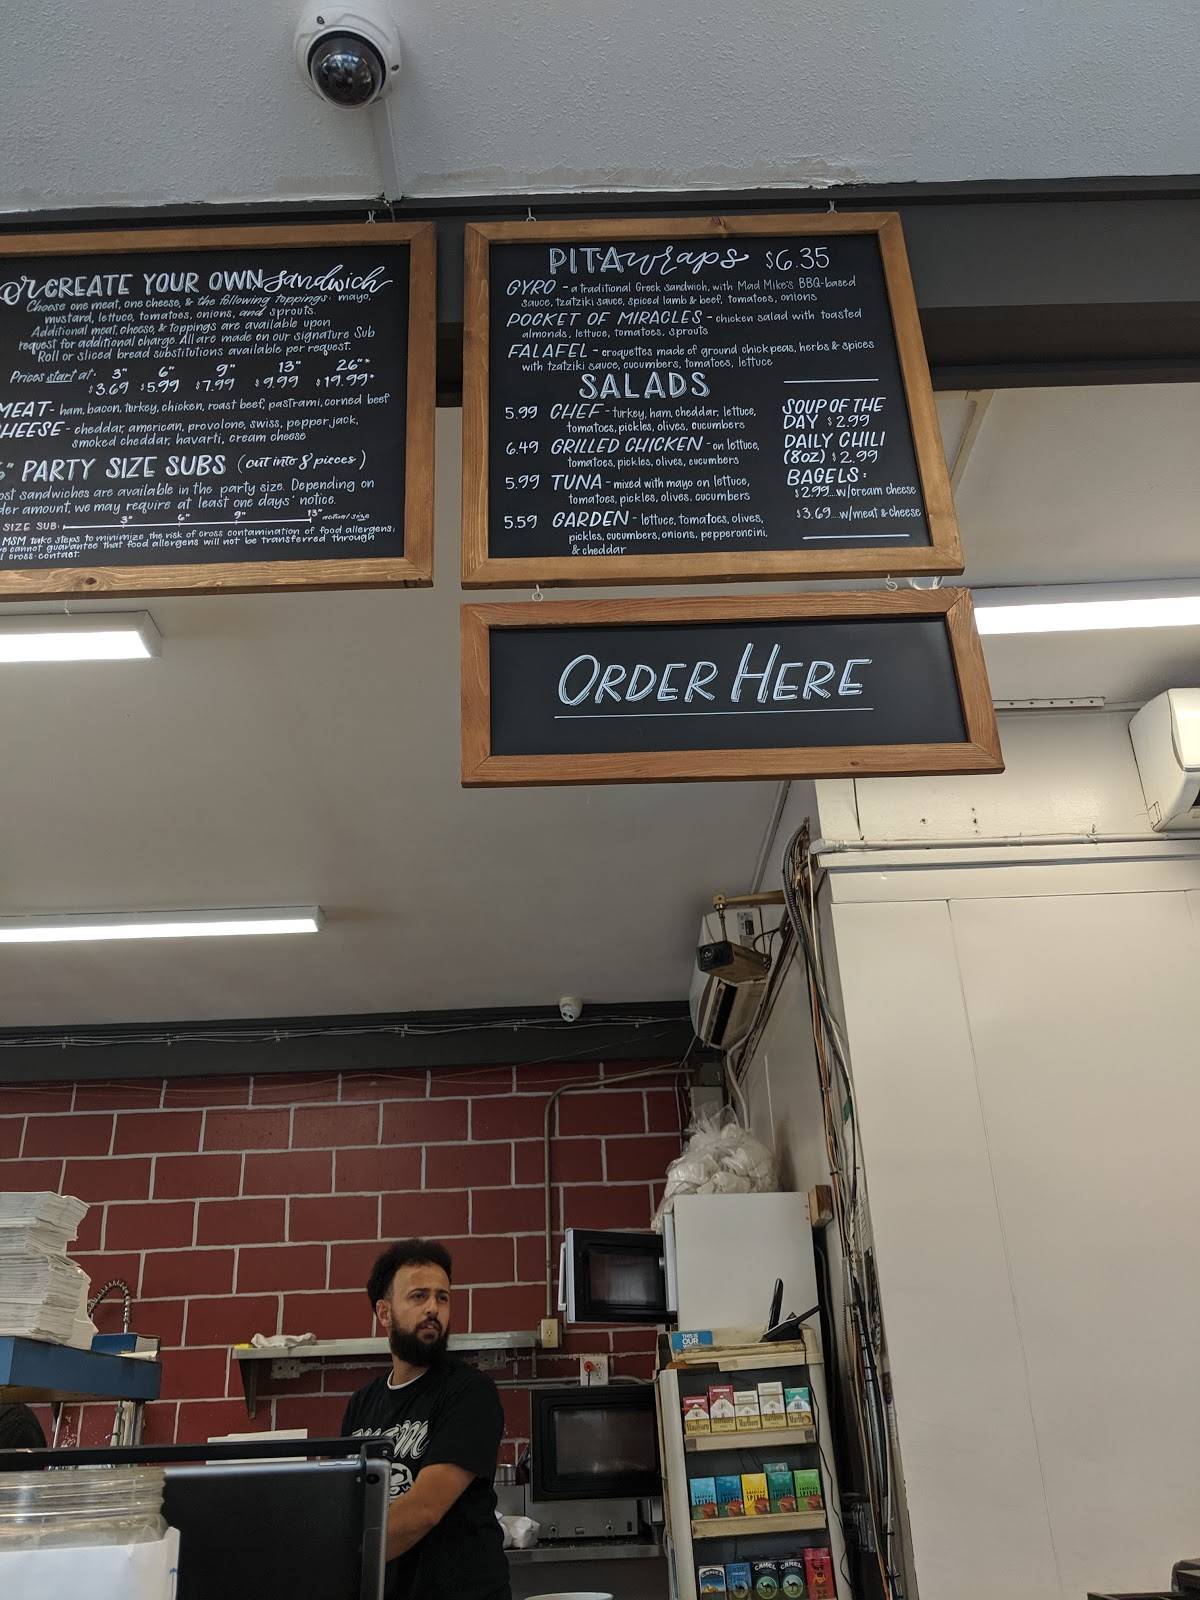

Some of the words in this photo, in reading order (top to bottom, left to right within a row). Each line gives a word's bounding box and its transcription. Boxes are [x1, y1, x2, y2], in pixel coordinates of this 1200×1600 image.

[550, 246, 624, 275] PITA
[766, 247, 829, 270] $6.35
[45, 274, 133, 298] CREATE
[144, 272, 199, 295] YOUR
[209, 269, 263, 291] OWN
[506, 280, 556, 295] GYRO
[581, 282, 631, 293] traditional
[636, 282, 661, 292] Greek
[737, 281, 760, 290] Mad
[764, 279, 794, 290] Mike's
[798, 276, 856, 289] BBQ-based
[26, 299, 65, 313] Choose
[70, 302, 91, 311] one
[91, 299, 121, 310] meat,
[124, 300, 143, 308] one
[146, 297, 181, 308] cheese,
[198, 295, 216, 307] the
[219, 294, 270, 307] following
[338, 293, 371, 303] mayo,
[556, 296, 594, 307] tzatziki
[627, 295, 659, 307] spiced
[663, 294, 687, 304] lamb
[728, 294, 777, 304] tomatoes,
[45, 312, 95, 325] mustard,
[98, 311, 135, 323] lettuce,
[139, 310, 193, 321] tomatoes,
[506, 312, 581, 327] POCKET
[587, 312, 611, 325] OF
[617, 310, 703, 326] MIRACLES
[716, 312, 753, 323] chicken
[757, 311, 788, 322] salad
[821, 307, 862, 319] toasted
[31, 324, 88, 338] Additional
[120, 323, 155, 336] cheese,
[170, 320, 216, 335] toppings
[245, 318, 298, 330] available
[303, 317, 330, 330] upon
[522, 329, 571, 339] almonds,
[576, 328, 610, 338] lettuce,
[614, 327, 665, 337] tomatoes,
[668, 325, 709, 338] sprouts
[78, 334, 134, 349] additional
[221, 333, 252, 343] made
[294, 330, 349, 345] signature
[62, 352, 74, 361] or
[77, 348, 111, 361] sliced
[117, 346, 150, 359] bread
[153, 345, 223, 359] substitutions
[228, 343, 282, 356] available
[508, 343, 588, 359] FALAFEL
[602, 345, 652, 360] croquettes
[657, 345, 684, 356] made
[701, 344, 737, 357] ground
[799, 340, 829, 352] herbs
[842, 340, 875, 352] spices
[548, 360, 585, 371] tzatziki
[623, 358, 681, 369] cucumbers,
[685, 357, 734, 368] tomatoes,
[738, 356, 773, 367] lettuce
[9, 370, 44, 384] Prices
[46, 369, 77, 383] start
[89, 382, 129, 395] $3.69
[140, 379, 179, 393] $5.99
[196, 378, 234, 392] $7.99
[255, 375, 299, 389] $9.99
[578, 371, 711, 400] SALADS
[87, 402, 122, 415] bacon,
[125, 402, 160, 414] turkey,
[162, 400, 205, 412] chicken,
[208, 399, 237, 412] roast
[269, 398, 322, 411] pastrami,
[325, 395, 362, 407] corned
[505, 405, 538, 420] 5.99
[550, 404, 604, 420] CHEF
[723, 405, 756, 417] lettuce,
[783, 398, 827, 414] SOUP
[830, 398, 850, 413] OF
[854, 397, 886, 412] THE
[74, 422, 124, 435] cheddar,
[129, 422, 184, 432] american,
[250, 417, 283, 429] swiss,
[567, 421, 616, 433] tomatoes,
[618, 421, 655, 435] pickles,
[691, 421, 745, 431] cucumbers
[783, 414, 818, 430] DAY
[828, 414, 870, 428] $2.99
[72, 436, 115, 448] smoked
[120, 435, 171, 446] cheddar,
[229, 434, 266, 443] cream
[270, 429, 306, 442] cheese
[505, 441, 539, 455] 6.49
[550, 438, 620, 455] GRILLED
[625, 436, 704, 453] CHICKEN
[785, 433, 833, 449] DAILY
[839, 431, 885, 447] CHILI
[567, 456, 615, 467] tomatoes,
[617, 456, 653, 469] pickles,
[689, 455, 739, 465] cucumbers
[832, 450, 878, 464] $2.99
[21, 458, 96, 482] PARTY
[106, 456, 157, 479] SIZE
[165, 454, 226, 476] SUBS
[19, 485, 89, 500] sandwiches
[118, 483, 173, 497] available
[193, 482, 212, 494] the
[221, 481, 255, 496] party
[291, 476, 355, 493] Depending
[505, 475, 540, 490] 5.99
[552, 474, 602, 491] TUNA
[613, 478, 641, 489] mixed
[666, 479, 693, 490] mayo
[713, 475, 749, 487] lettuce,
[886, 483, 916, 495] cheese
[568, 493, 617, 505] tomatoes,
[695, 491, 750, 501] cucumbers
[126, 501, 171, 514] require
[889, 506, 921, 517] cheese
[3, 523, 30, 532] SIZE
[351, 512, 369, 520] size
[504, 515, 538, 529] 5.59
[552, 510, 629, 528] GARDEN
[678, 513, 729, 525] tomatoes,
[2, 536, 26, 546] MSM
[31, 536, 52, 545] take
[55, 535, 80, 548] steps
[96, 532, 144, 542] minimize
[149, 532, 162, 540] the
[165, 530, 182, 539] risk
[228, 526, 299, 537] contamination
[10, 545, 43, 553] cannot
[47, 543, 98, 555] guarantee
[103, 541, 121, 549] that
[127, 540, 148, 548] food
[152, 538, 199, 548] allergens
[223, 536, 240, 545] not
[261, 534, 326, 544] transferred
[332, 533, 375, 543] through
[582, 544, 627, 555] cheddar
[755, 1562, 776, 1570] CAMEL
[780, 1561, 802, 1570] CAMEL
